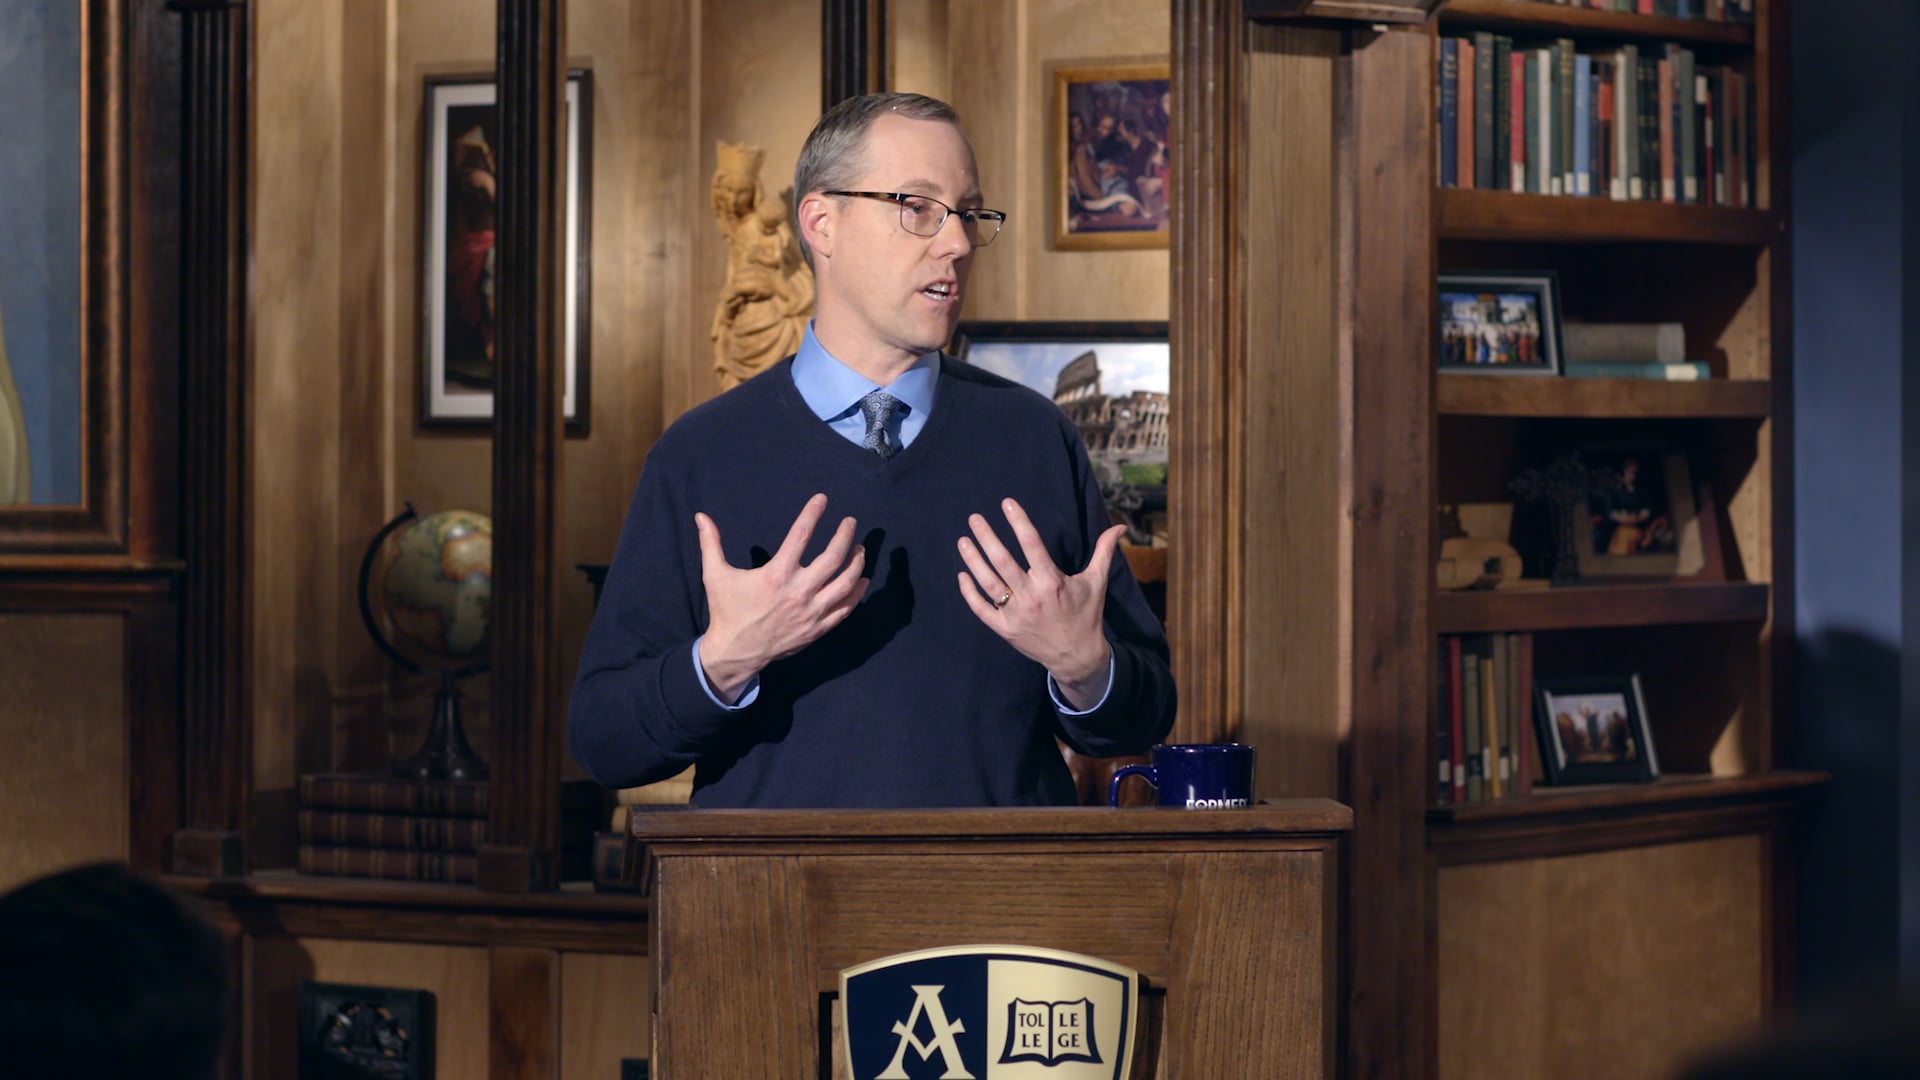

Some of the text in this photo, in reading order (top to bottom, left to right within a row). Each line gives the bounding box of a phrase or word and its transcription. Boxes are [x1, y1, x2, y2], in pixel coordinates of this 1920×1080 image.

[1018, 1013, 1045, 1028] TOL
[1059, 1013, 1079, 1027] LE
[1022, 1034, 1042, 1048] LE
[1058, 1033, 1081, 1048] GE
